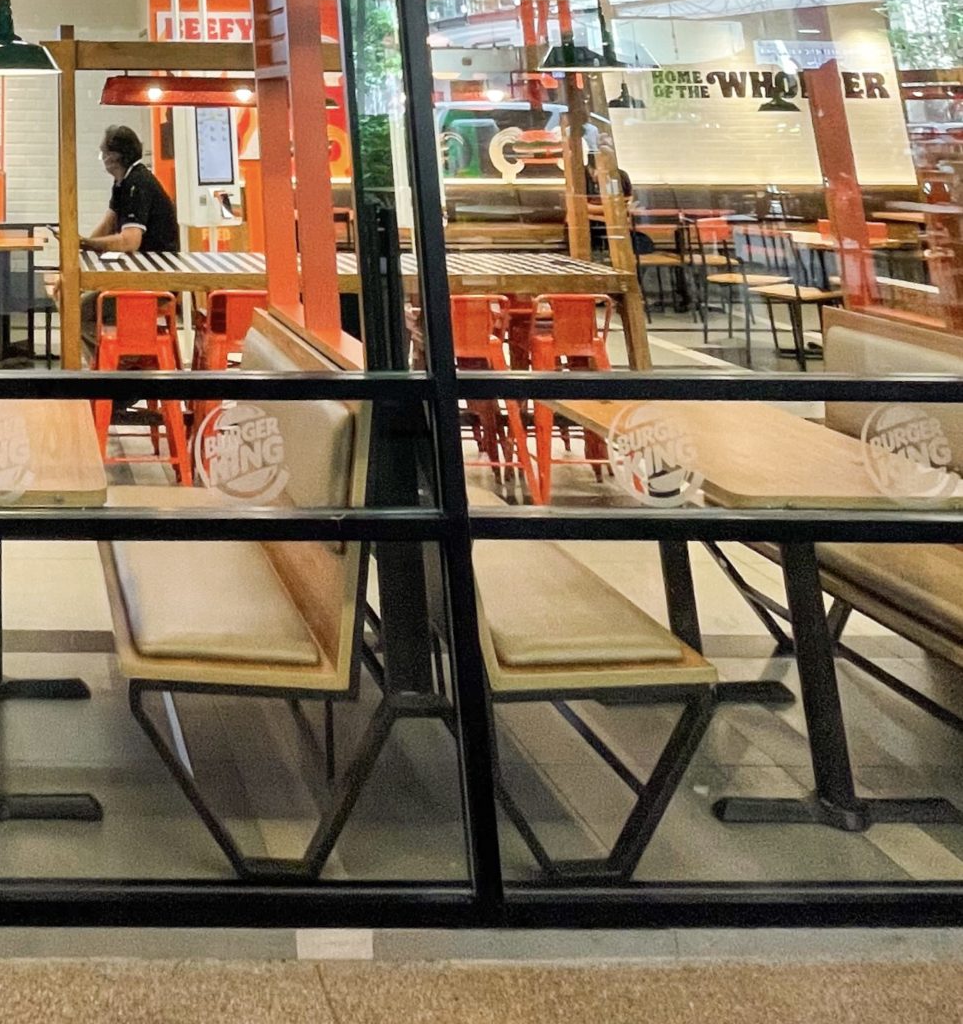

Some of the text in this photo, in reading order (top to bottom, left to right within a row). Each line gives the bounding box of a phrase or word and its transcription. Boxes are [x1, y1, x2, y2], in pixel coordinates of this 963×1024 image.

[652, 71, 702, 84] HOME
[654, 85, 710, 98] OF THE
[706, 71, 890, 99] WHOER
[205, 417, 280, 459] BURGER
[870, 417, 943, 460] BURGER
[209, 435, 284, 486] KING
[618, 440, 698, 485] KING
